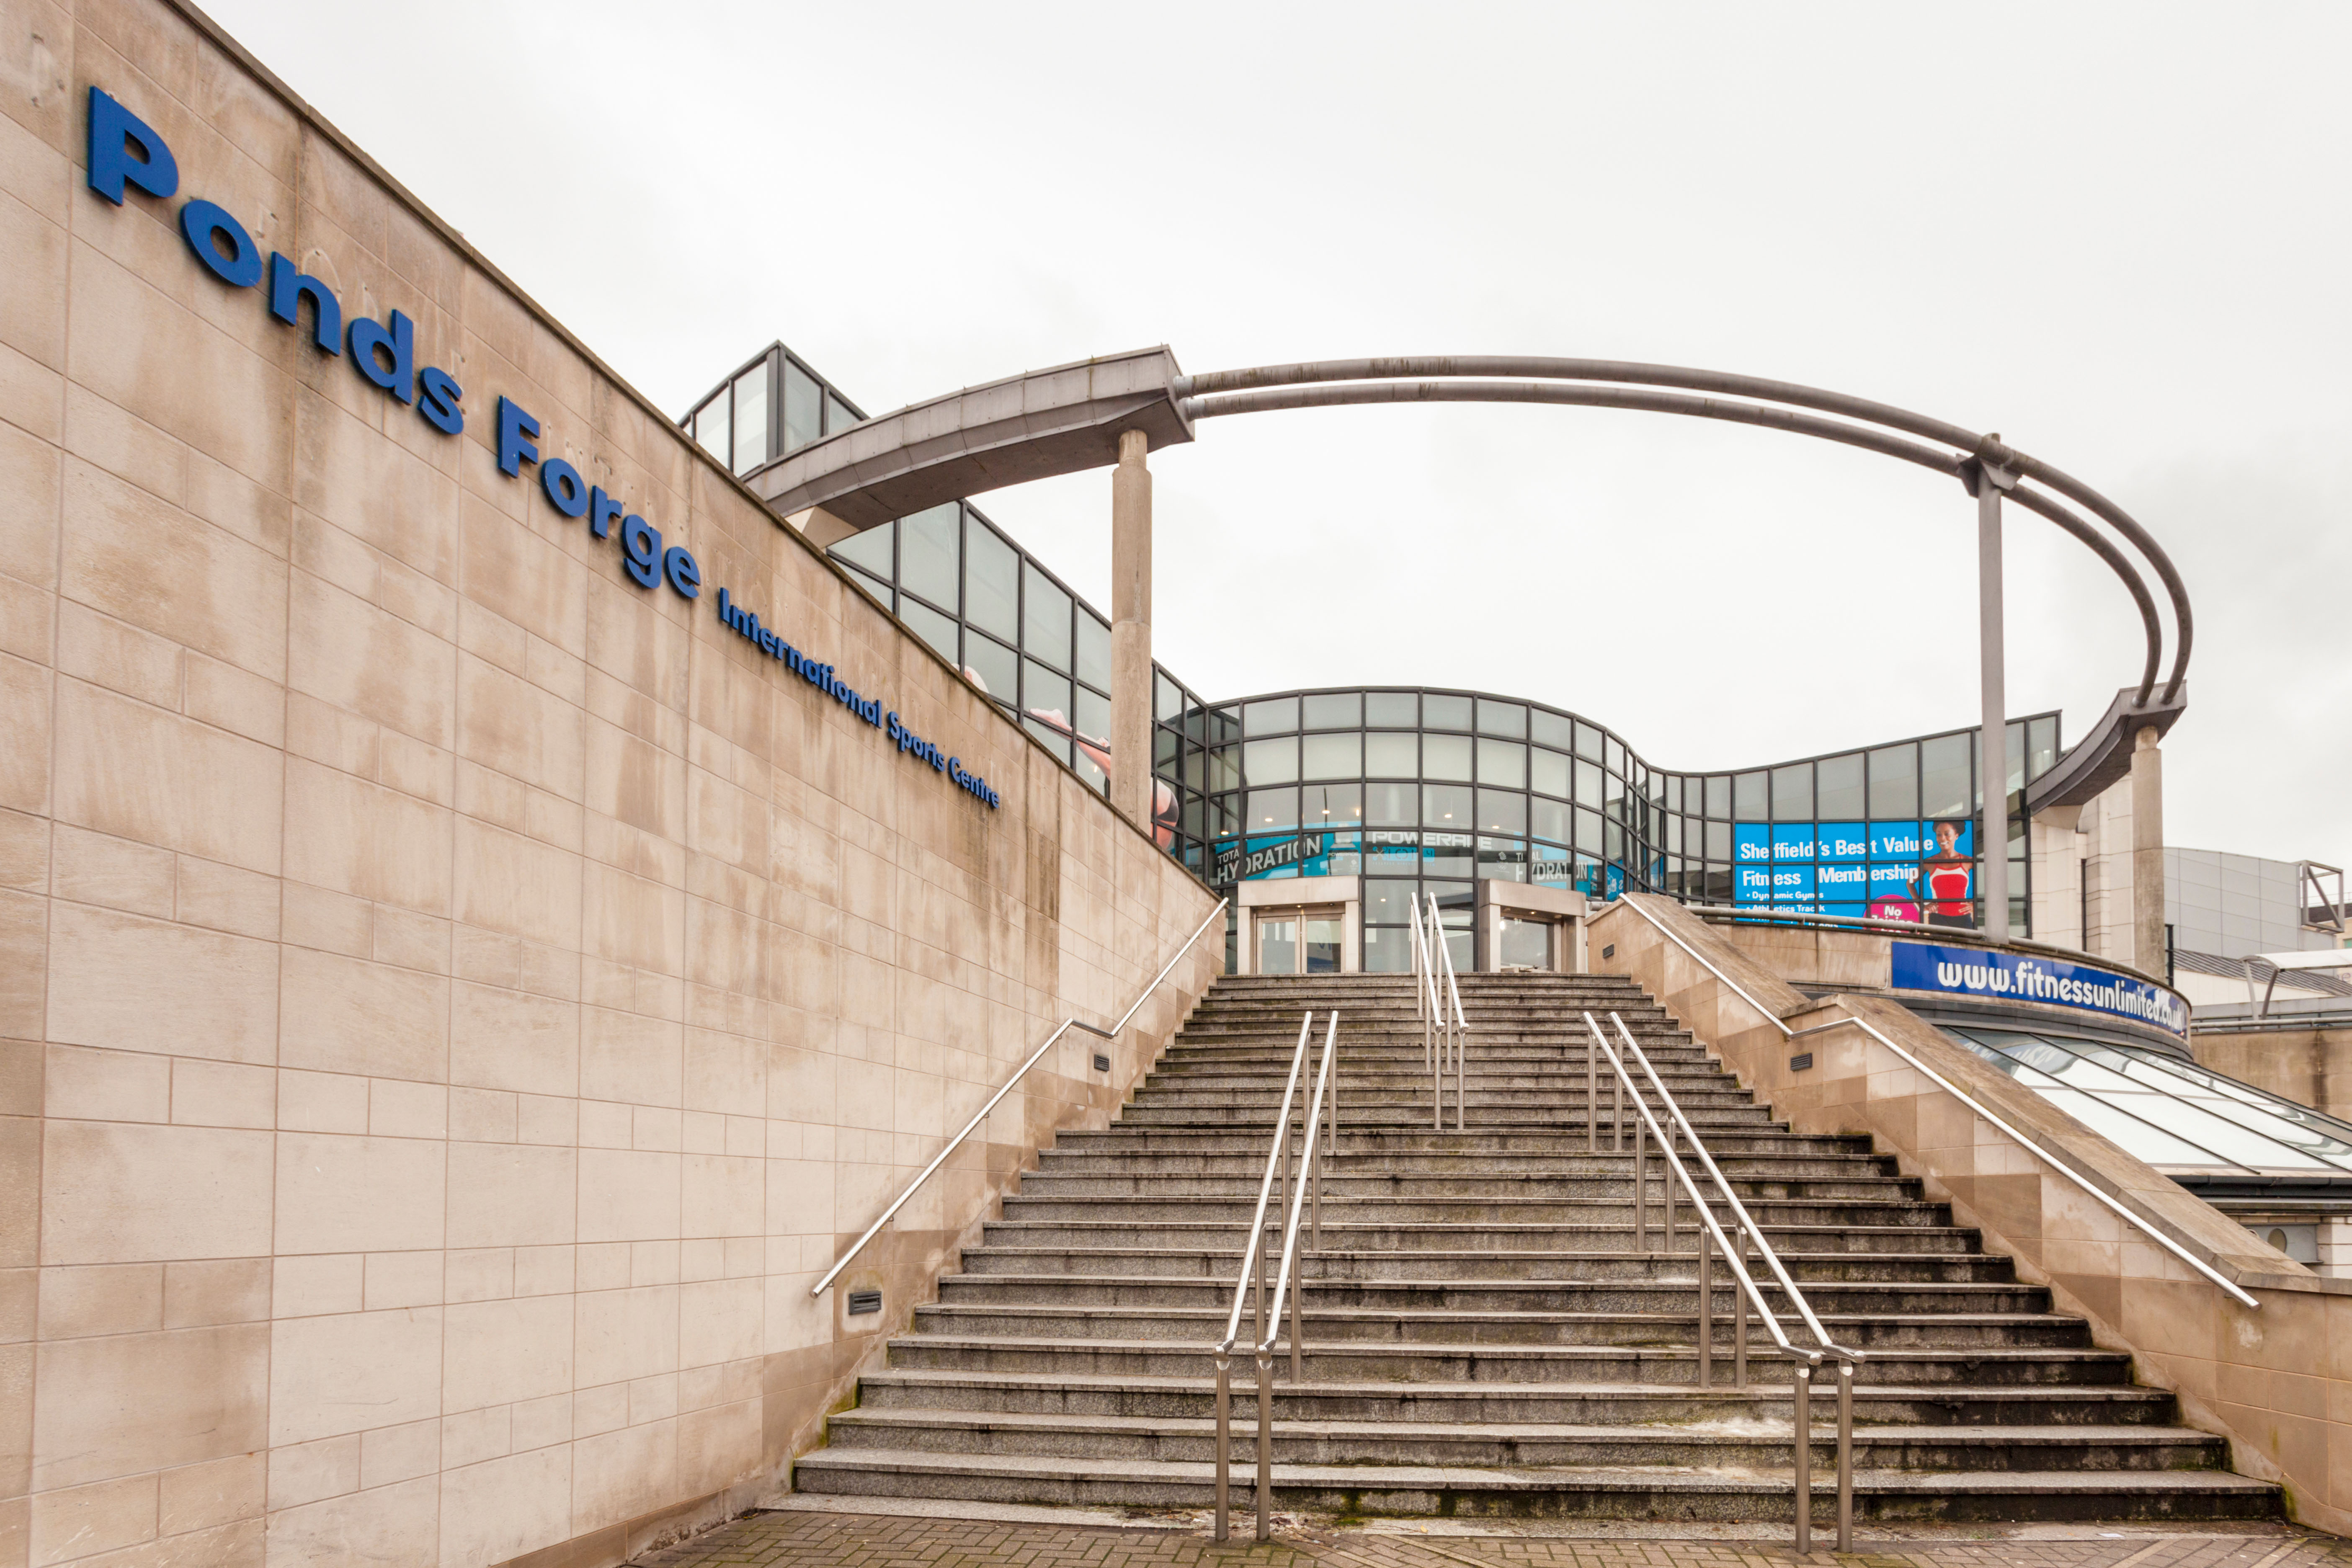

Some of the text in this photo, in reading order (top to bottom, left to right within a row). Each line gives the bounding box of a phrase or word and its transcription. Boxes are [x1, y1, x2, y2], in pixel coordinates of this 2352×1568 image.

[88, 85, 1000, 809] Ponds Forge International Sports Centre
[1217, 848, 1239, 864] TOTA
[1740, 836, 1933, 859] Sheffield's Best Value
[1516, 861, 1587, 882] HYDRATON
[1743, 864, 1919, 886] Fitness Membership
[1752, 891, 1824, 901] Dynamic Gyms
[1884, 905, 1902, 917] No
[1937, 961, 2182, 1032] www.fitnessunlimited.co.uk
